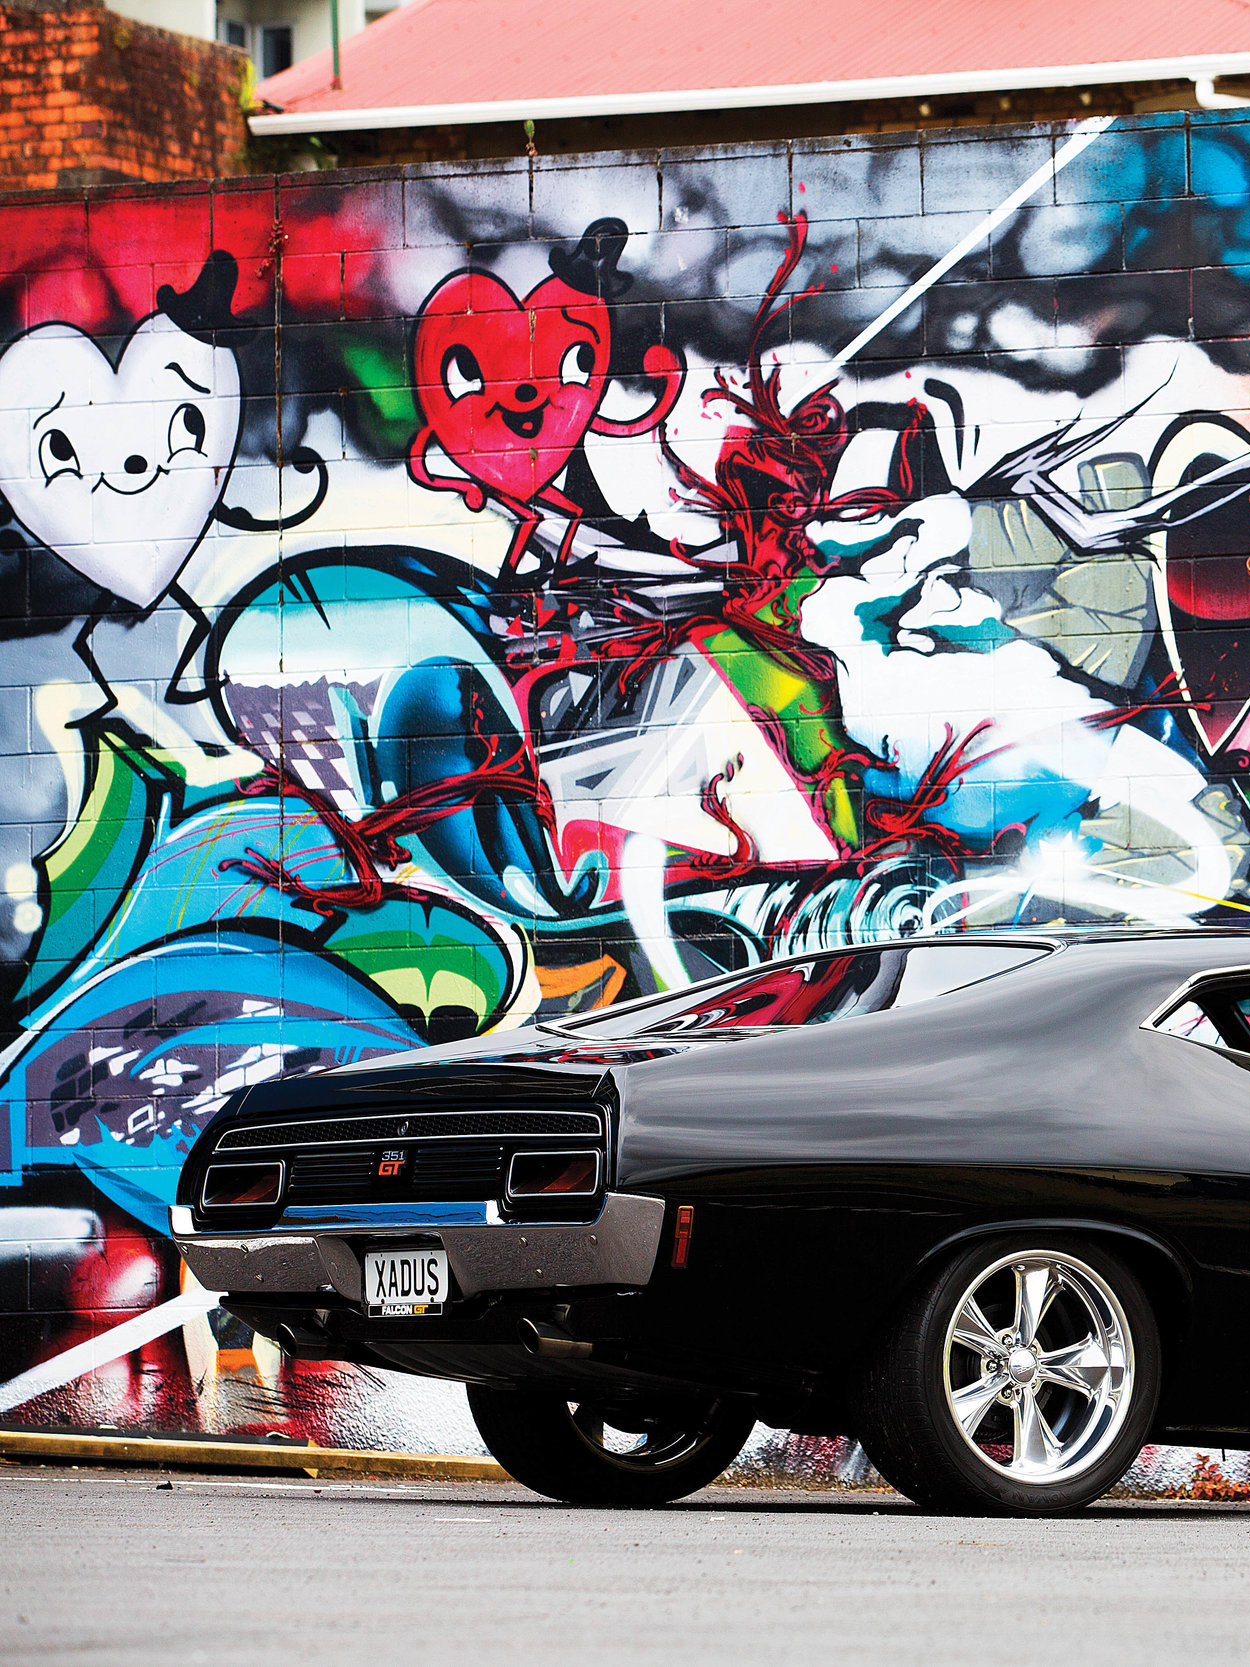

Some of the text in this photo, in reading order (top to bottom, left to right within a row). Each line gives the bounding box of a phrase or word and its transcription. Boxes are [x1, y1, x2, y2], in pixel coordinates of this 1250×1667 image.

[382, 1150, 404, 1161] 351
[379, 1161, 404, 1175] GT
[374, 1257, 440, 1298] XADUS
[381, 1304, 429, 1316] FALCON GT
